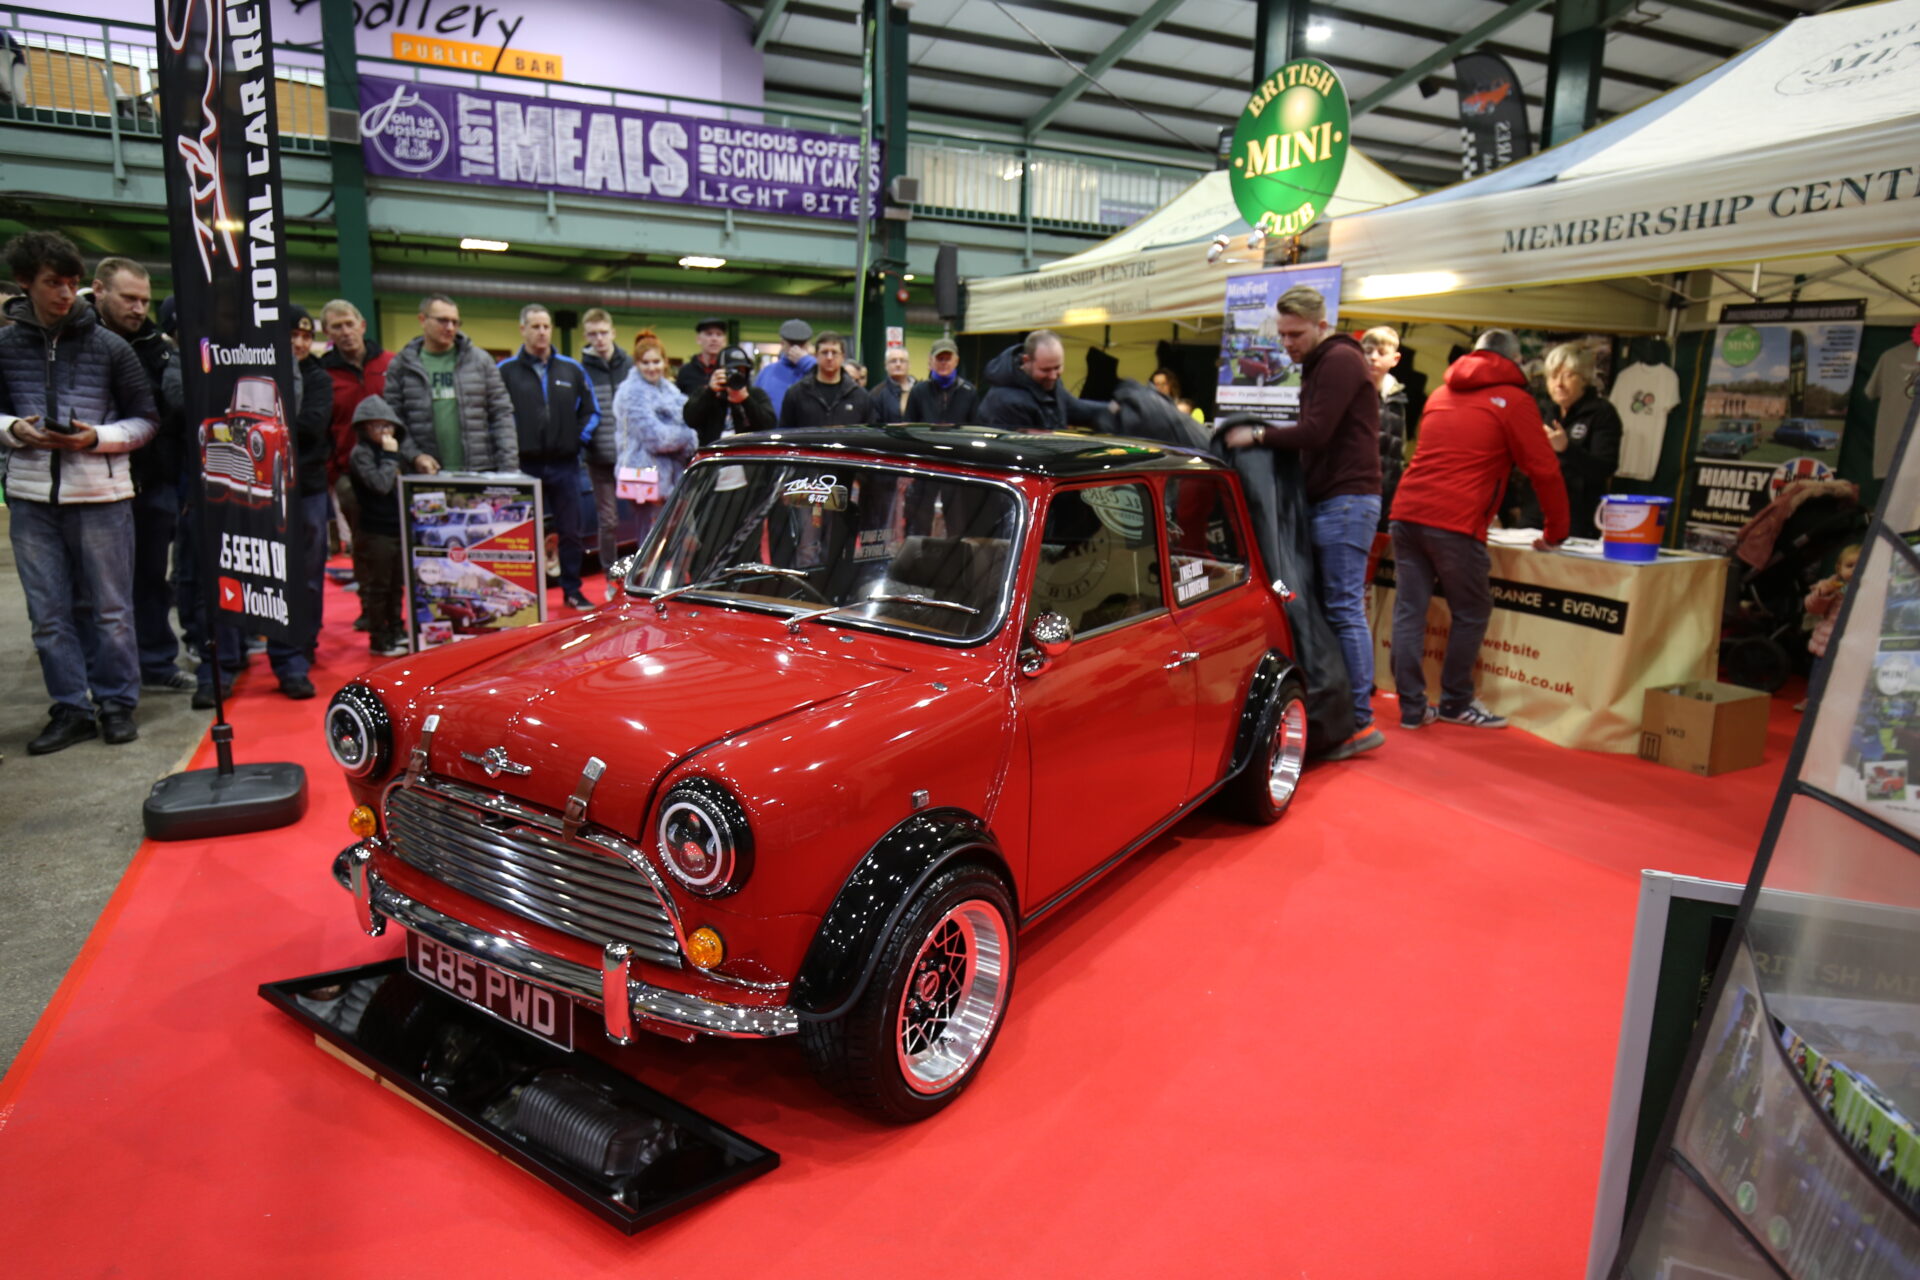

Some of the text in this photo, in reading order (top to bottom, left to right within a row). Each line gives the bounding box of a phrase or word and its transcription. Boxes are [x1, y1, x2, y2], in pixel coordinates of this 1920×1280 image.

[401, 41, 555, 75] PUBLIC BAR
[1248, 63, 1335, 118] BRITISH
[240, 77, 270, 177] CAR
[457, 93, 689, 198] TASTY MEALS
[700, 125, 798, 153] DELICIOUS
[699, 144, 880, 192] AND SCRUMMY CAKS
[1244, 121, 1333, 179] MINI
[700, 181, 789, 209] LIGHT
[1259, 202, 1315, 236] CLUB
[1502, 194, 1756, 254] MEMBERSHIP
[250, 184, 279, 328] TOTAL
[1023, 260, 1157, 292] MEMBERSHIP CENTRE
[1697, 467, 1770, 491] HIMLEY
[1706, 489, 1751, 510] HALL
[233, 535, 271, 577] SEEN
[1561, 598, 1619, 624] EVENTS
[1482, 637, 1541, 660] website
[418, 936, 555, 1036] E85 PWD
